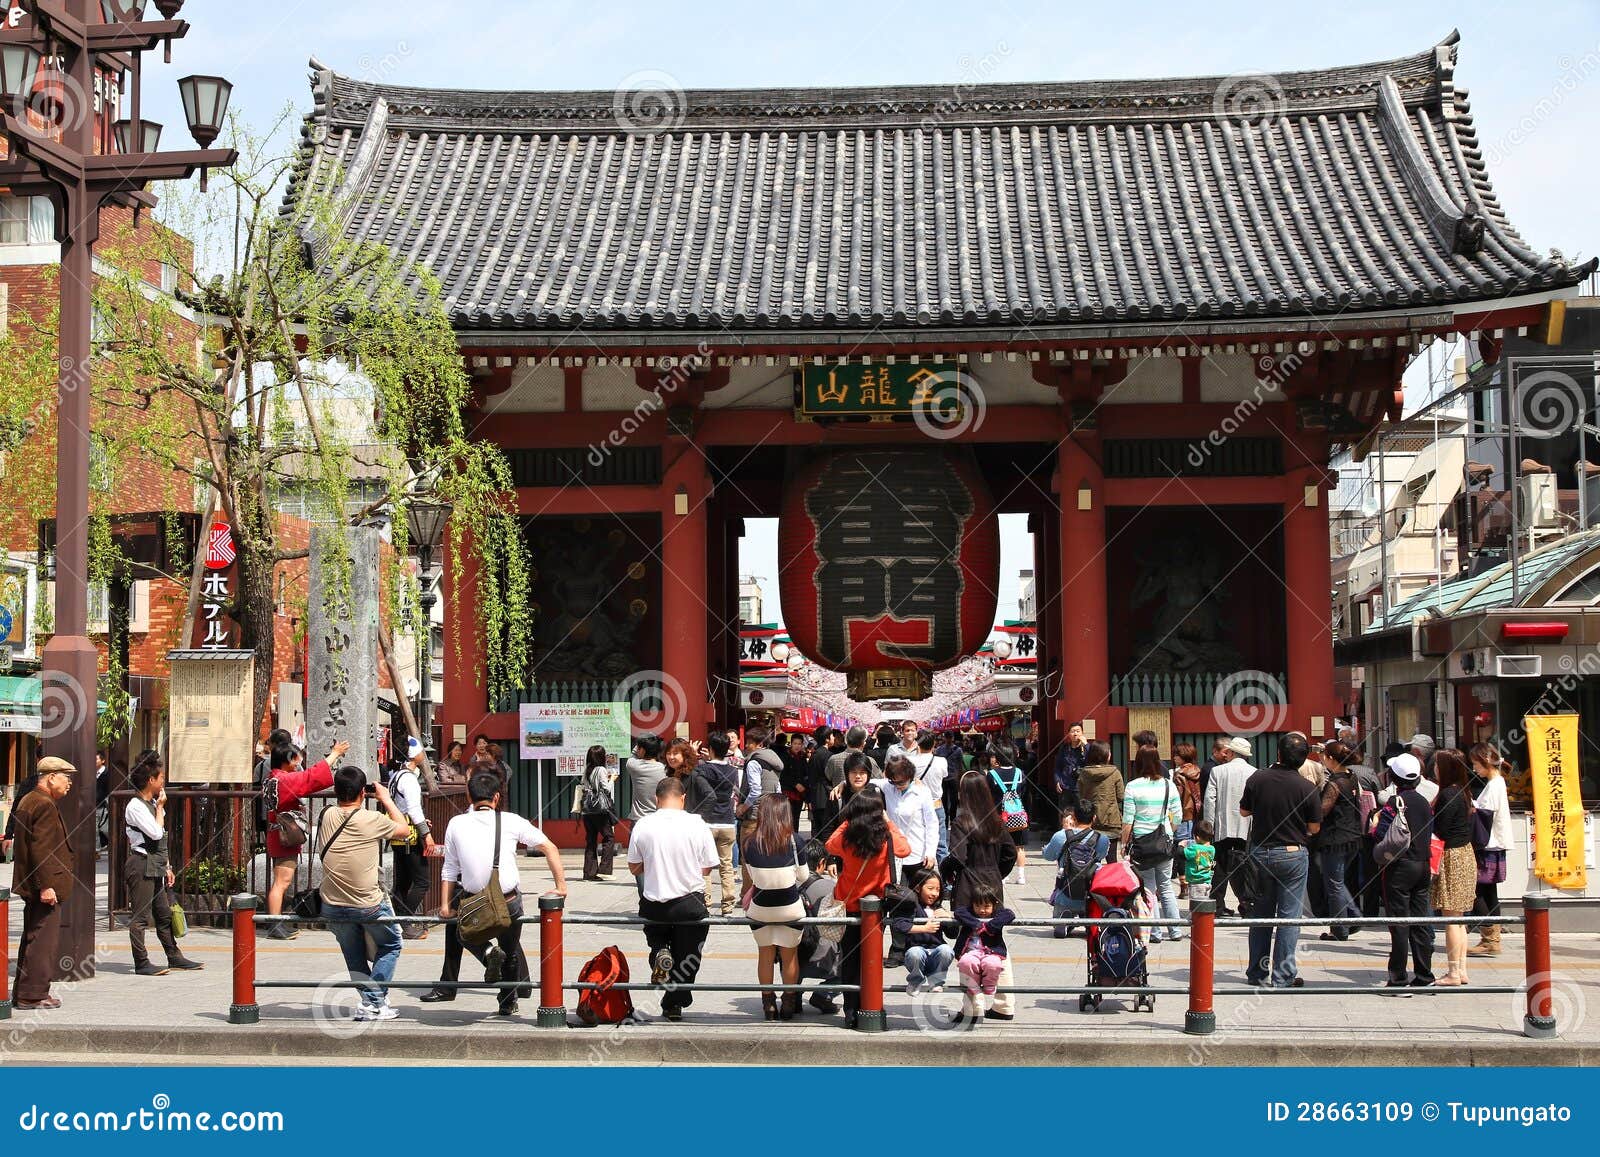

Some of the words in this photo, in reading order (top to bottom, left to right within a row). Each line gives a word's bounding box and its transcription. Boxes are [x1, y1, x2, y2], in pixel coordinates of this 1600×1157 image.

[804, 452, 976, 666] 雷門
[1545, 727, 1568, 861] 全国交通安全運動実施中
